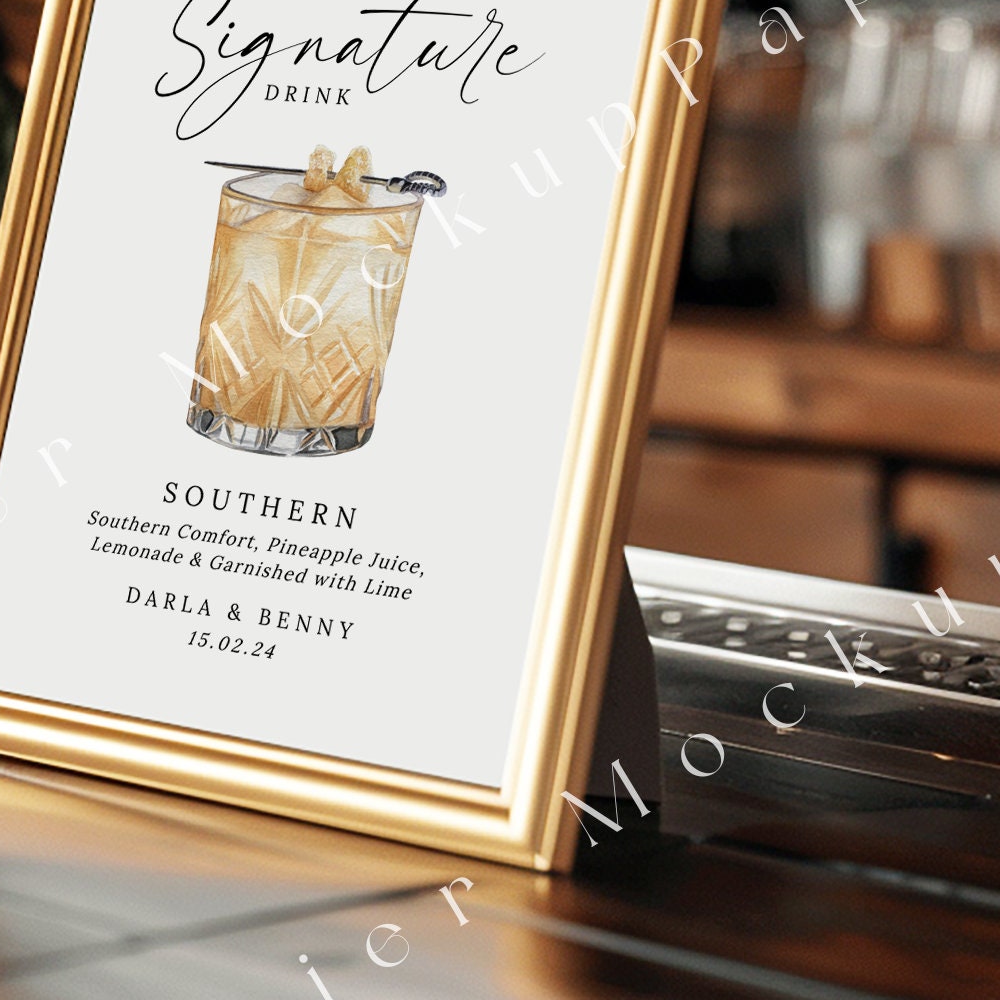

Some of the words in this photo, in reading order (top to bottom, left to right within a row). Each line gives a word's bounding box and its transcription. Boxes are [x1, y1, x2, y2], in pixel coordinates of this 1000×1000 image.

[264, 84, 351, 105] DRINK
[162, 481, 357, 530] SOUTHERN
[87, 510, 171, 537] Southern
[177, 524, 259, 553] Comfort,
[266, 537, 363, 567] Pineapple
[367, 552, 425, 578] Juice,
[90, 536, 184, 564] Lemonade
[189, 552, 202, 568] &
[209, 555, 309, 584] Garnished
[315, 574, 357, 592] with
[363, 578, 413, 600] Lime
[126, 586, 211, 617] DARLA
[227, 603, 241, 622] &
[258, 607, 354, 640] BENNY
[188, 631, 276, 660] 15.02.24
